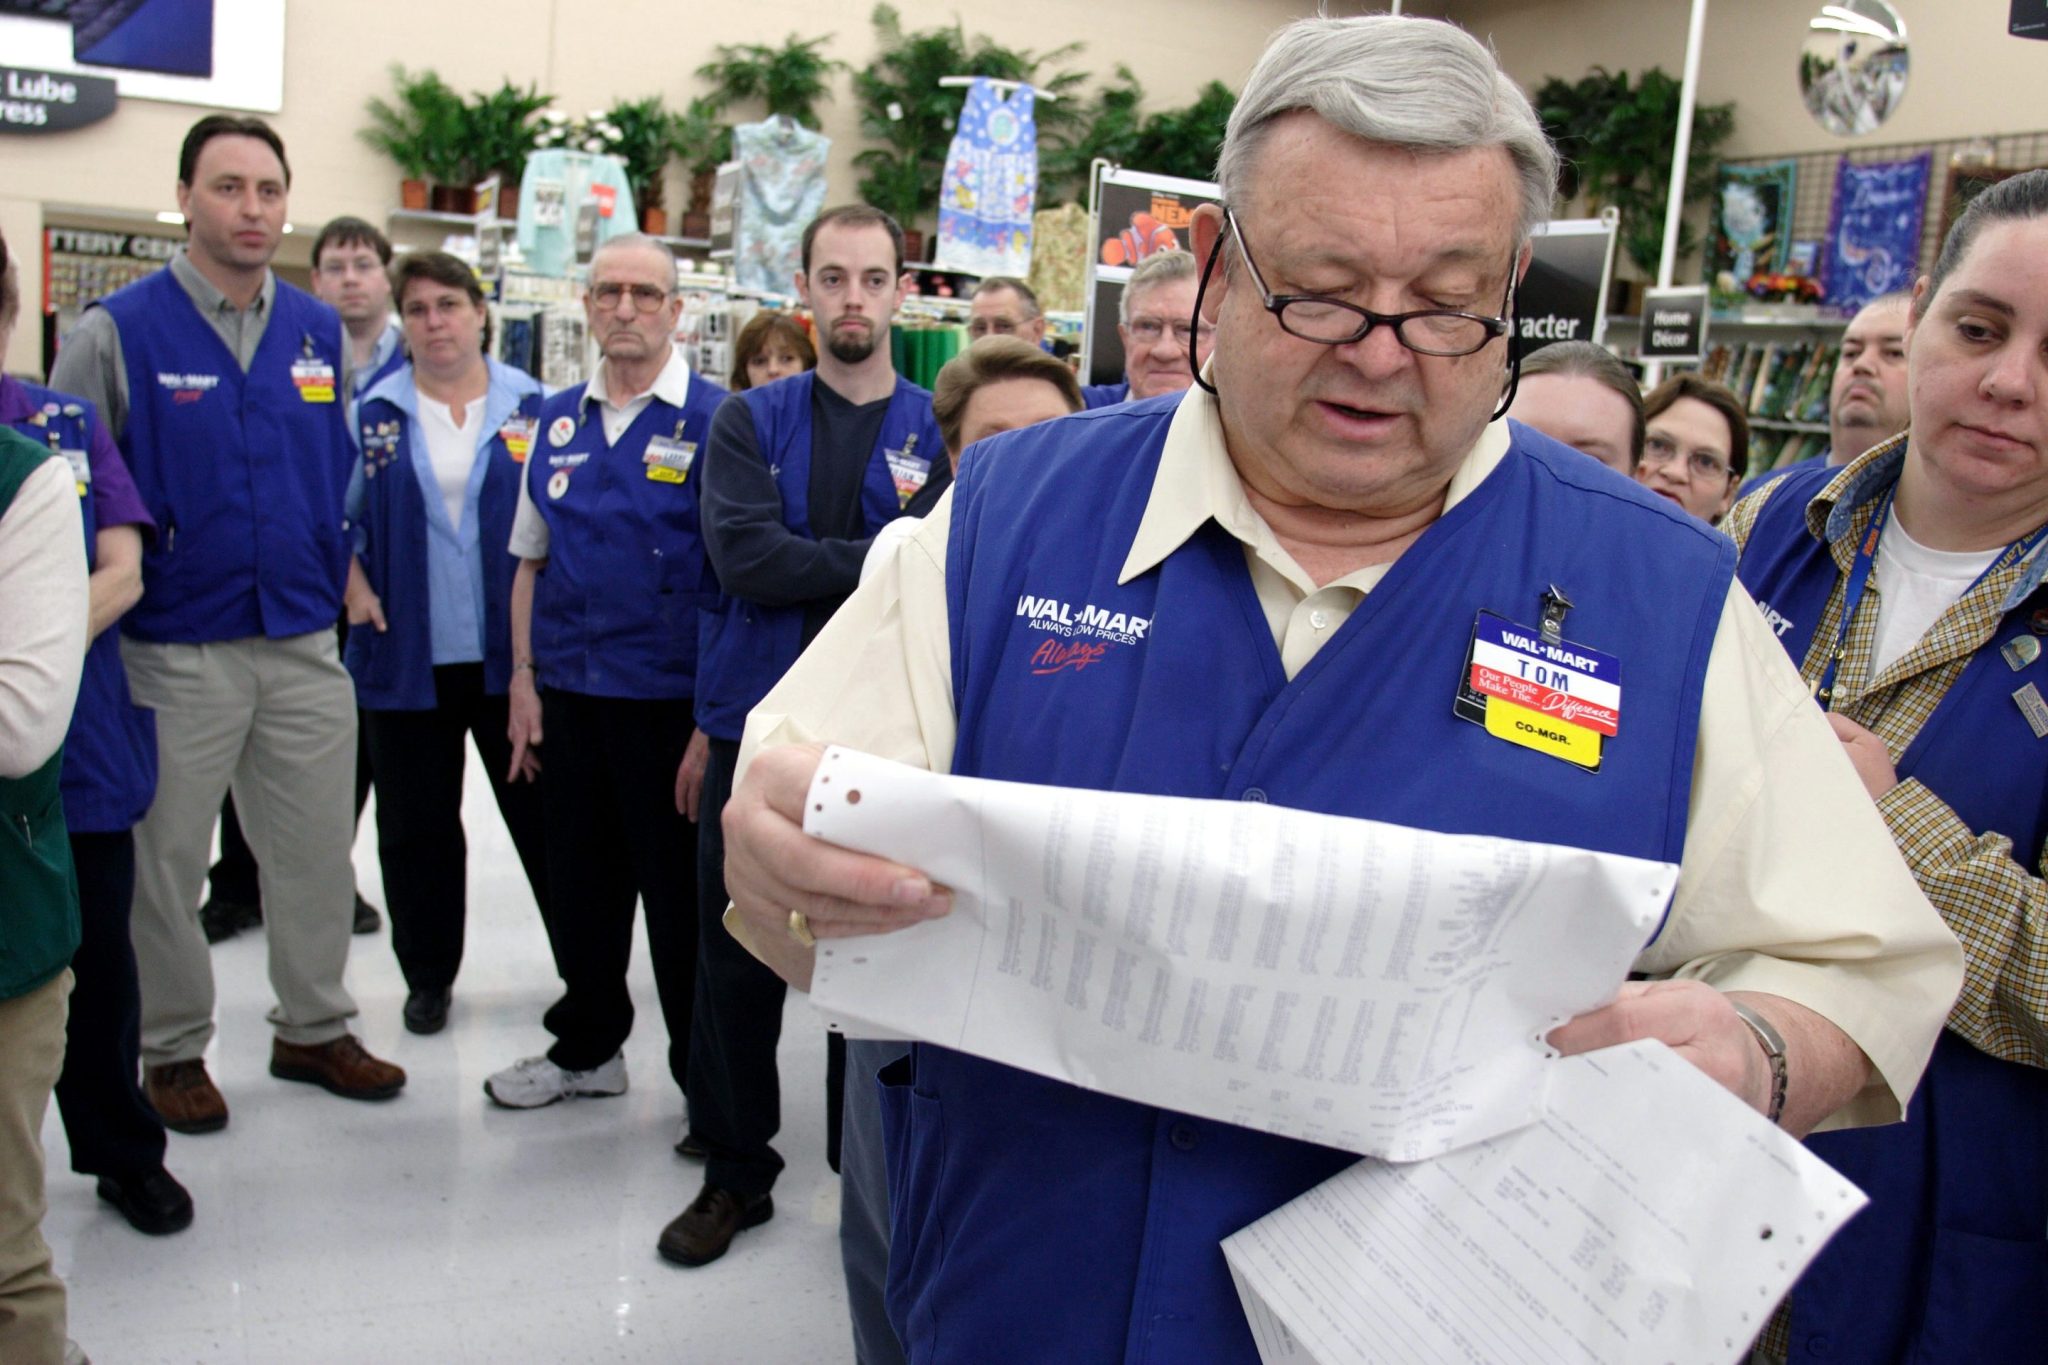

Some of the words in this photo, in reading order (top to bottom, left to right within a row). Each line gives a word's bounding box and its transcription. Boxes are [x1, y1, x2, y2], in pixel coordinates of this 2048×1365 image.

[7, 70, 78, 104] Lube
[1152, 203, 1195, 225] NEM
[1508, 313, 1579, 339] acter
[1653, 310, 1691, 327] Home
[1029, 619, 1072, 637] ALWAYS
[1095, 629, 1137, 646] PRICES
[1030, 638, 1109, 672] Always
[1479, 668, 1500, 682] Our
[1502, 675, 1538, 695] People
[1479, 677, 1509, 695] Make
[1518, 658, 1569, 693] TOM
[1541, 691, 1617, 720] Difference
[1515, 720, 1571, 745] CO-MGR.
